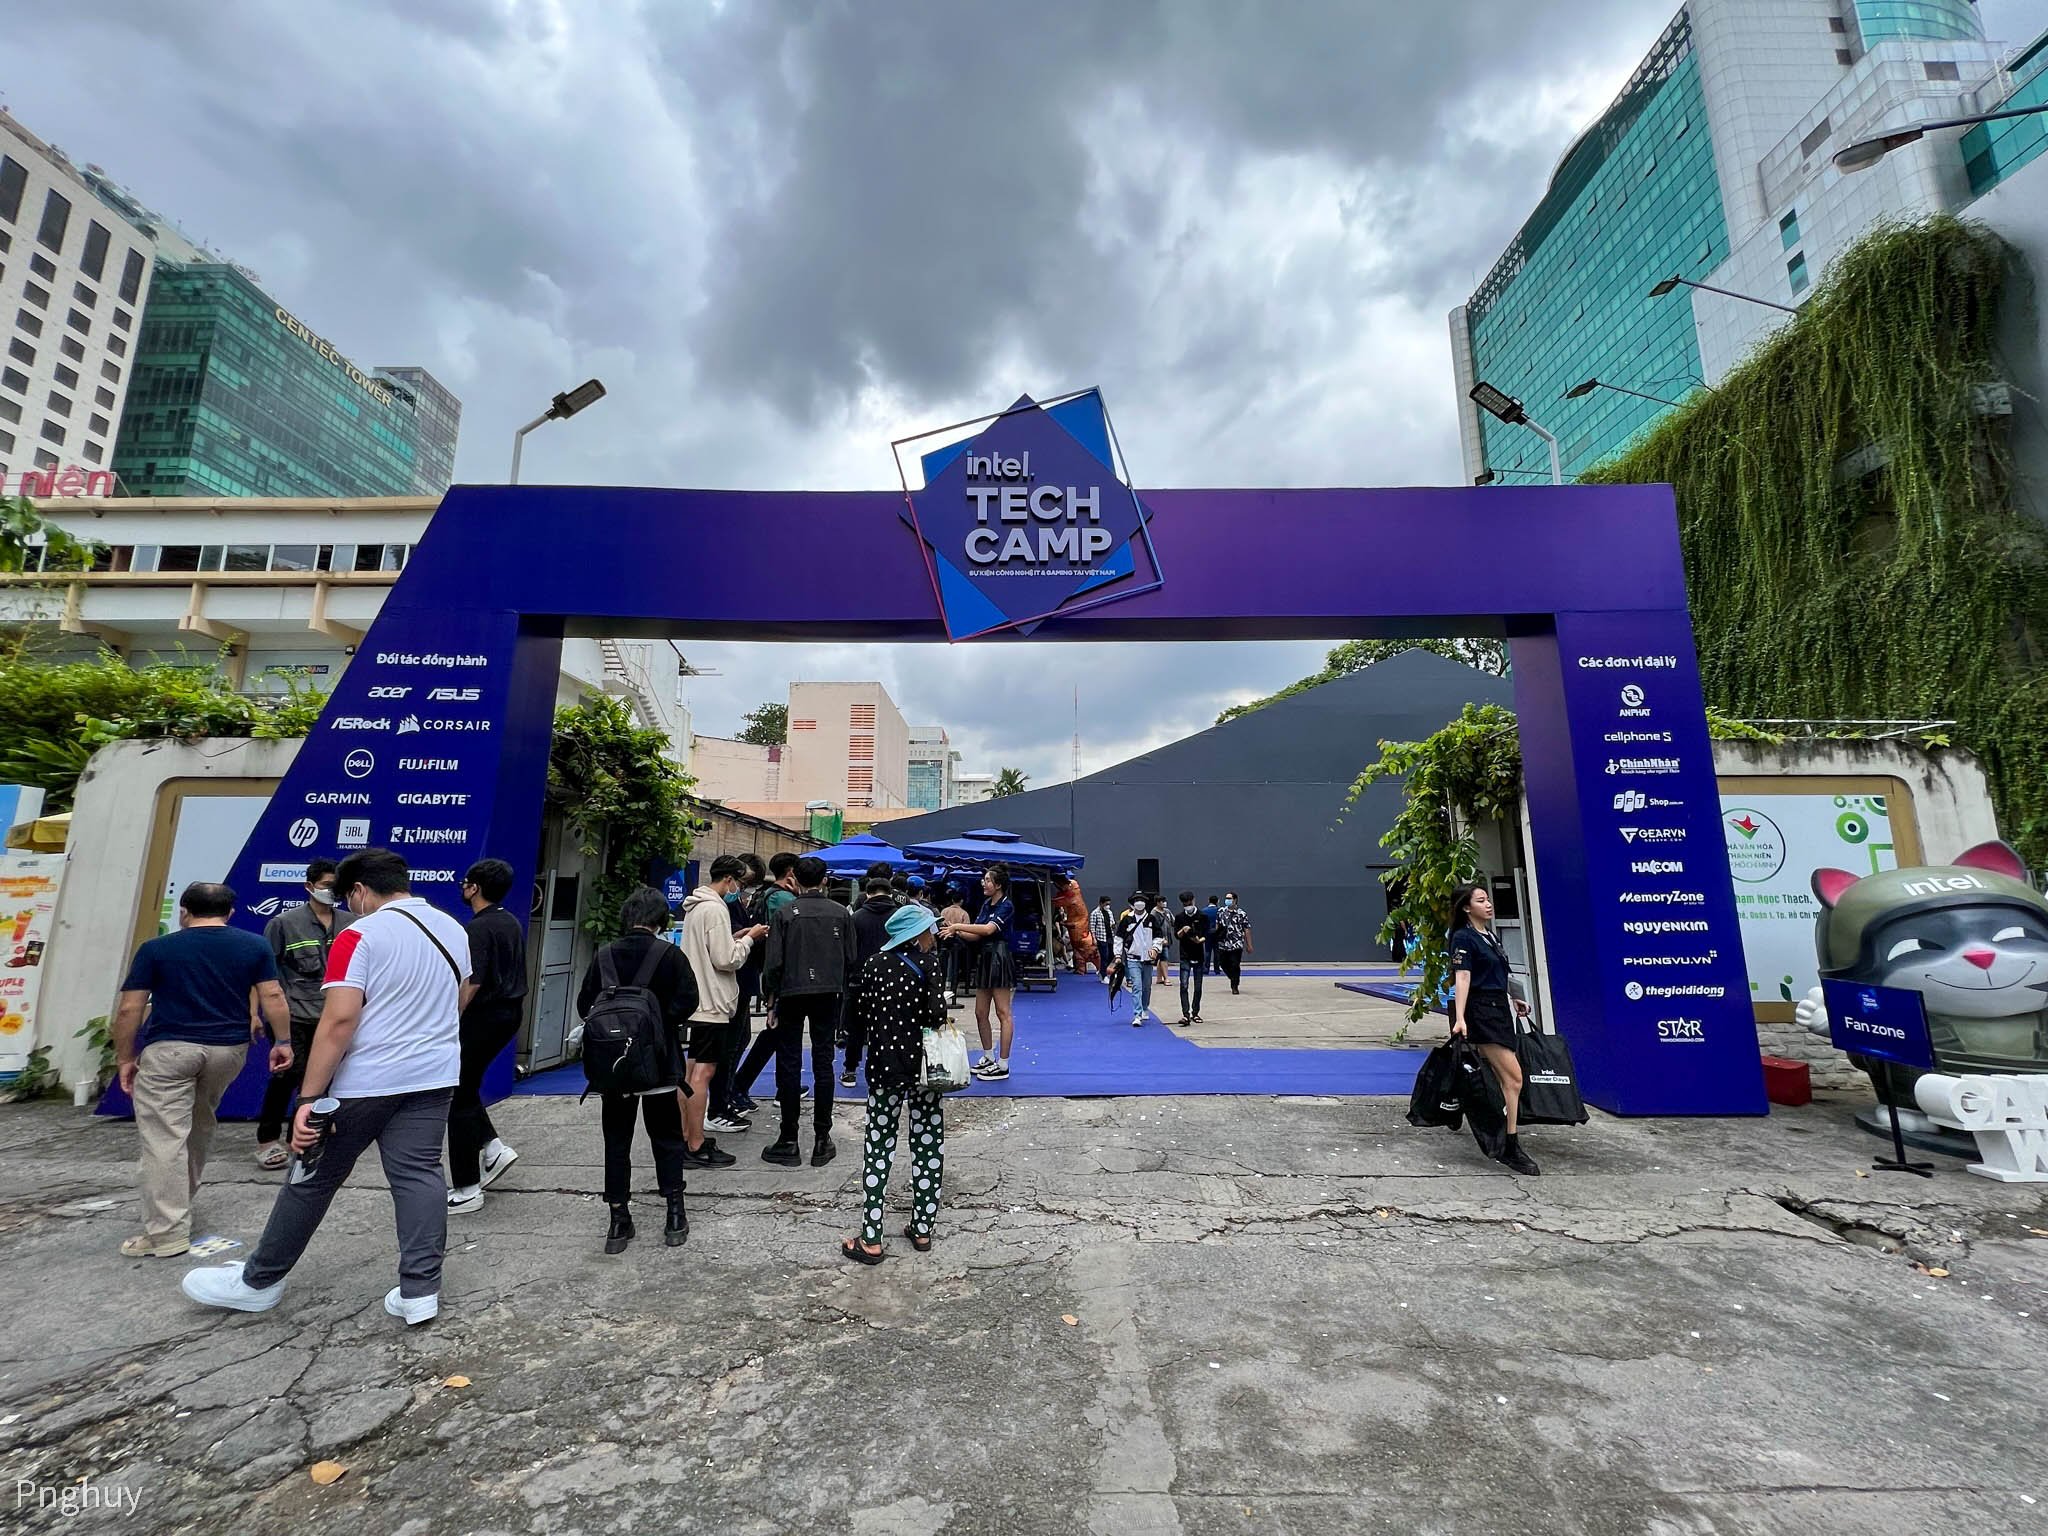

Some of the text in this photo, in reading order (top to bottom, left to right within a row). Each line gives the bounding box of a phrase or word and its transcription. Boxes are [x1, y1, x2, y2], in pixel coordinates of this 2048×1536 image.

[275, 308, 392, 408] CENTEC TOWER
[19, 462, 114, 498] niên
[966, 485, 1100, 521] TECH
[965, 527, 1112, 563] CAMP
[1046, 569, 1073, 577] GAMING
[1099, 569, 1116, 577] NAM
[400, 653, 420, 665] tác
[456, 655, 487, 666] hành
[1578, 656, 1604, 668] Các
[1631, 656, 1643, 669] vị
[1644, 656, 1664, 668] đại
[1664, 655, 1677, 668] lý
[368, 686, 412, 698] acer
[426, 688, 481, 700] ASUS
[330, 717, 391, 730] ASRock
[423, 720, 491, 731] CORSAIR
[398, 758, 459, 771] FUJIFILM
[397, 793, 468, 806] GIGABYTE
[291, 819, 317, 847] hp
[404, 826, 468, 843] Kingston
[1639, 828, 1686, 838] GEARVN
[1631, 860, 1683, 875] HACOM
[407, 870, 456, 882] TERBOX
[1619, 890, 1704, 904] MemoryZone
[1623, 956, 1712, 966] PHONGVU.VN
[1657, 1016, 1704, 1037] STAR
[1844, 1016, 1905, 1039] Fan zone
